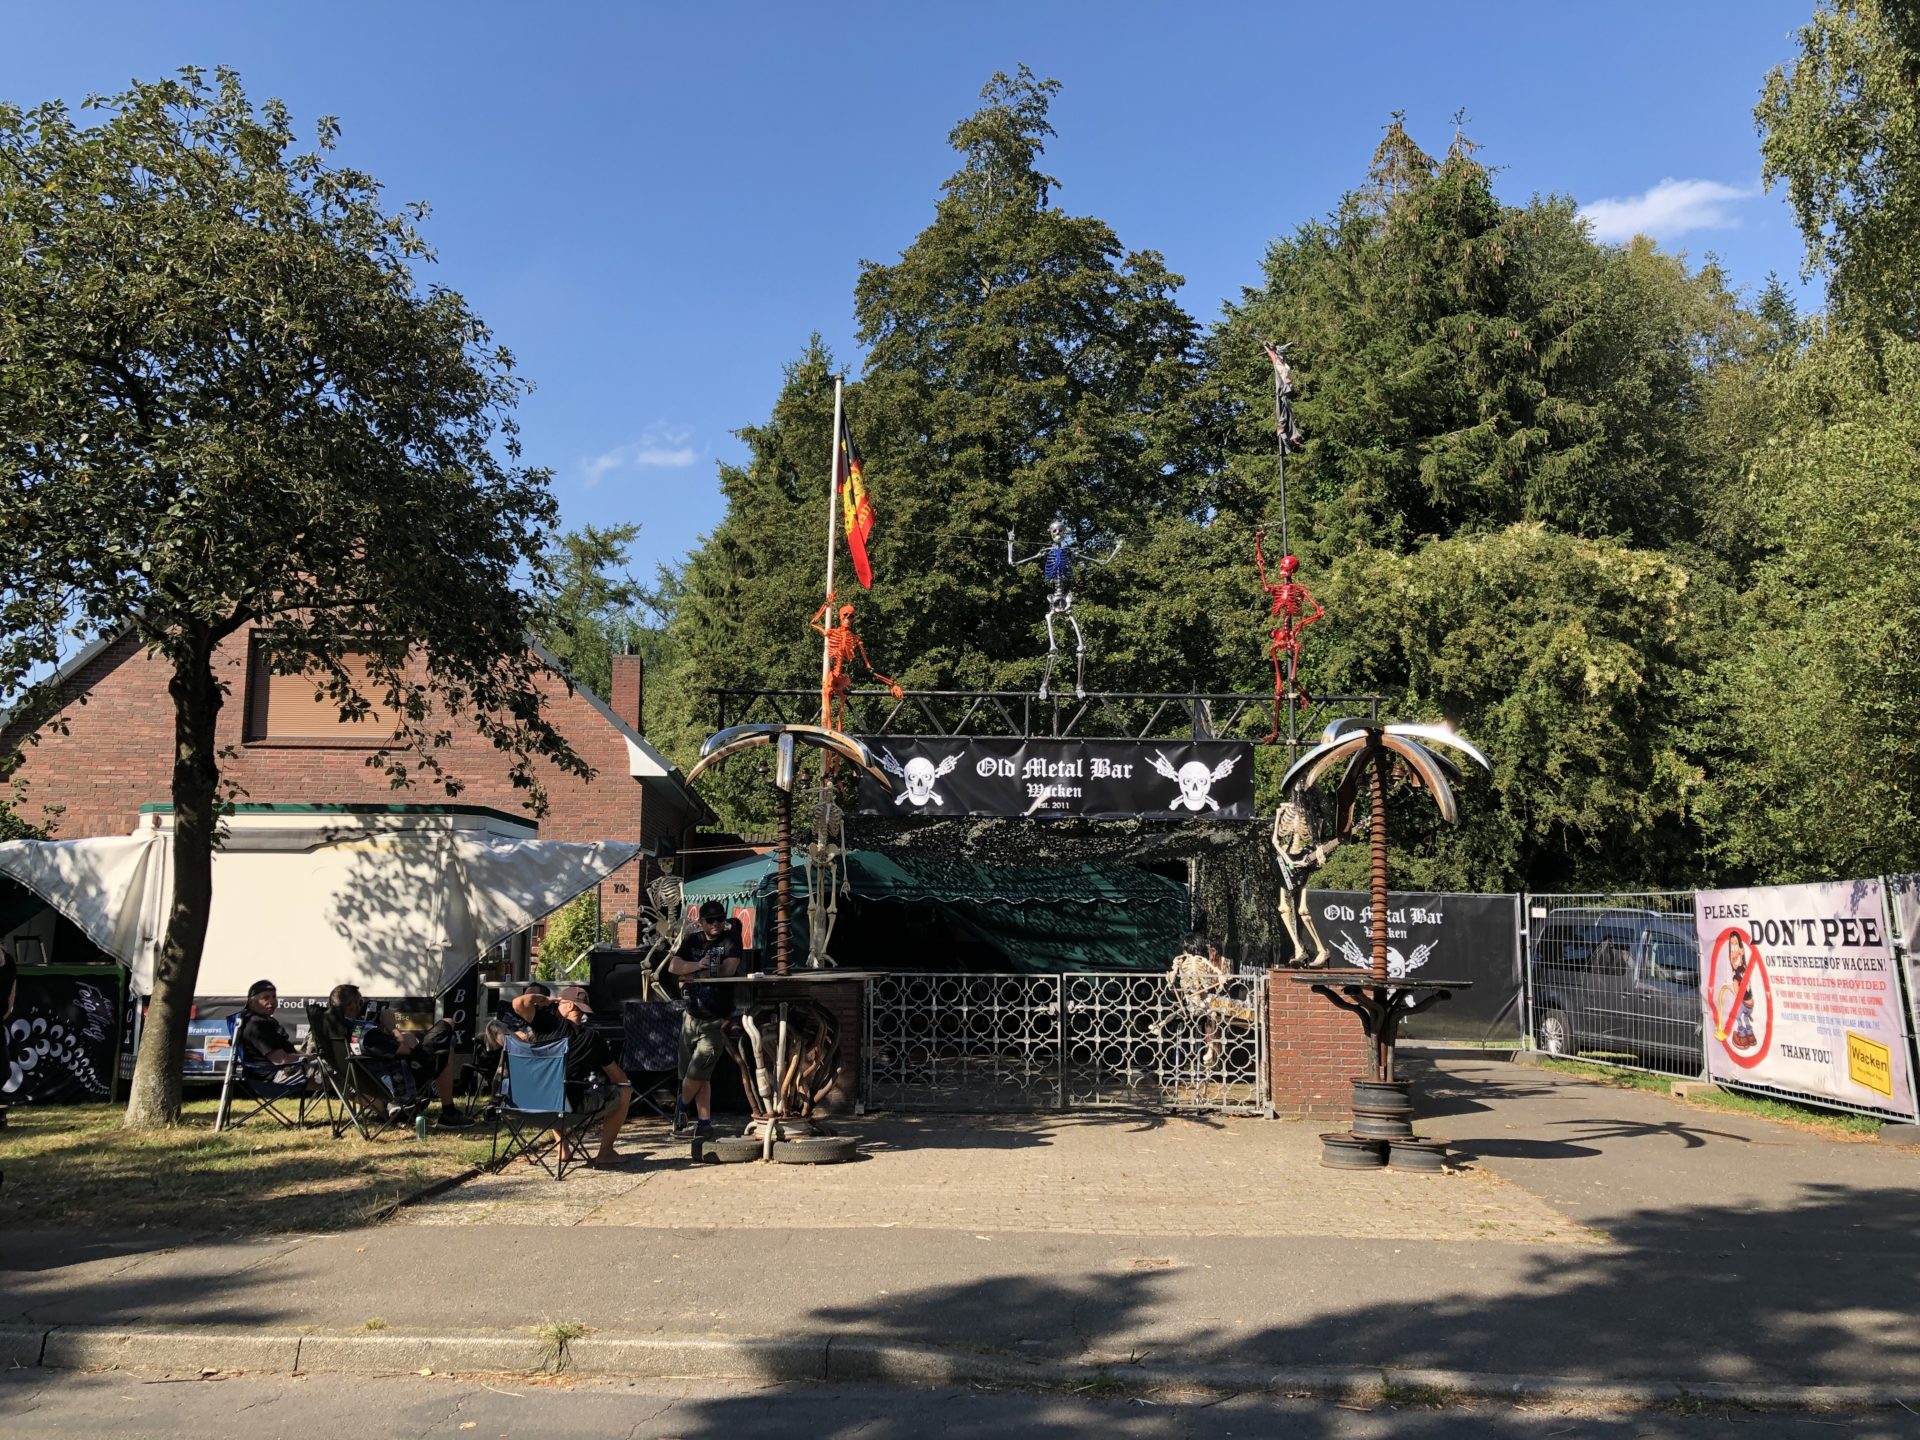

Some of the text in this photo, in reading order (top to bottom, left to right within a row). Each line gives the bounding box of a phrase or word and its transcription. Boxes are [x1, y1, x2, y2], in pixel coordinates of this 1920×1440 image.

[976, 757, 1133, 780] Old Metal Bar
[1026, 783, 1082, 798] Wacken
[1052, 802, 1070, 810] 2011
[1324, 904, 1444, 925] Old Mtal Bar
[1704, 904, 1750, 919] PLEASE
[1364, 926, 1408, 939] Wken
[1748, 918, 1883, 947] DON'T PEE
[1766, 955, 1887, 972] ON THE STREETS OF WACKEN!
[1769, 975, 1887, 991] USE THE TOILETS PROVIDED
[73, 981, 110, 1042] Feigling
[277, 998, 304, 1009] Food
[1780, 1044, 1811, 1061] THANK
[1851, 1045, 1888, 1072] Wacken
